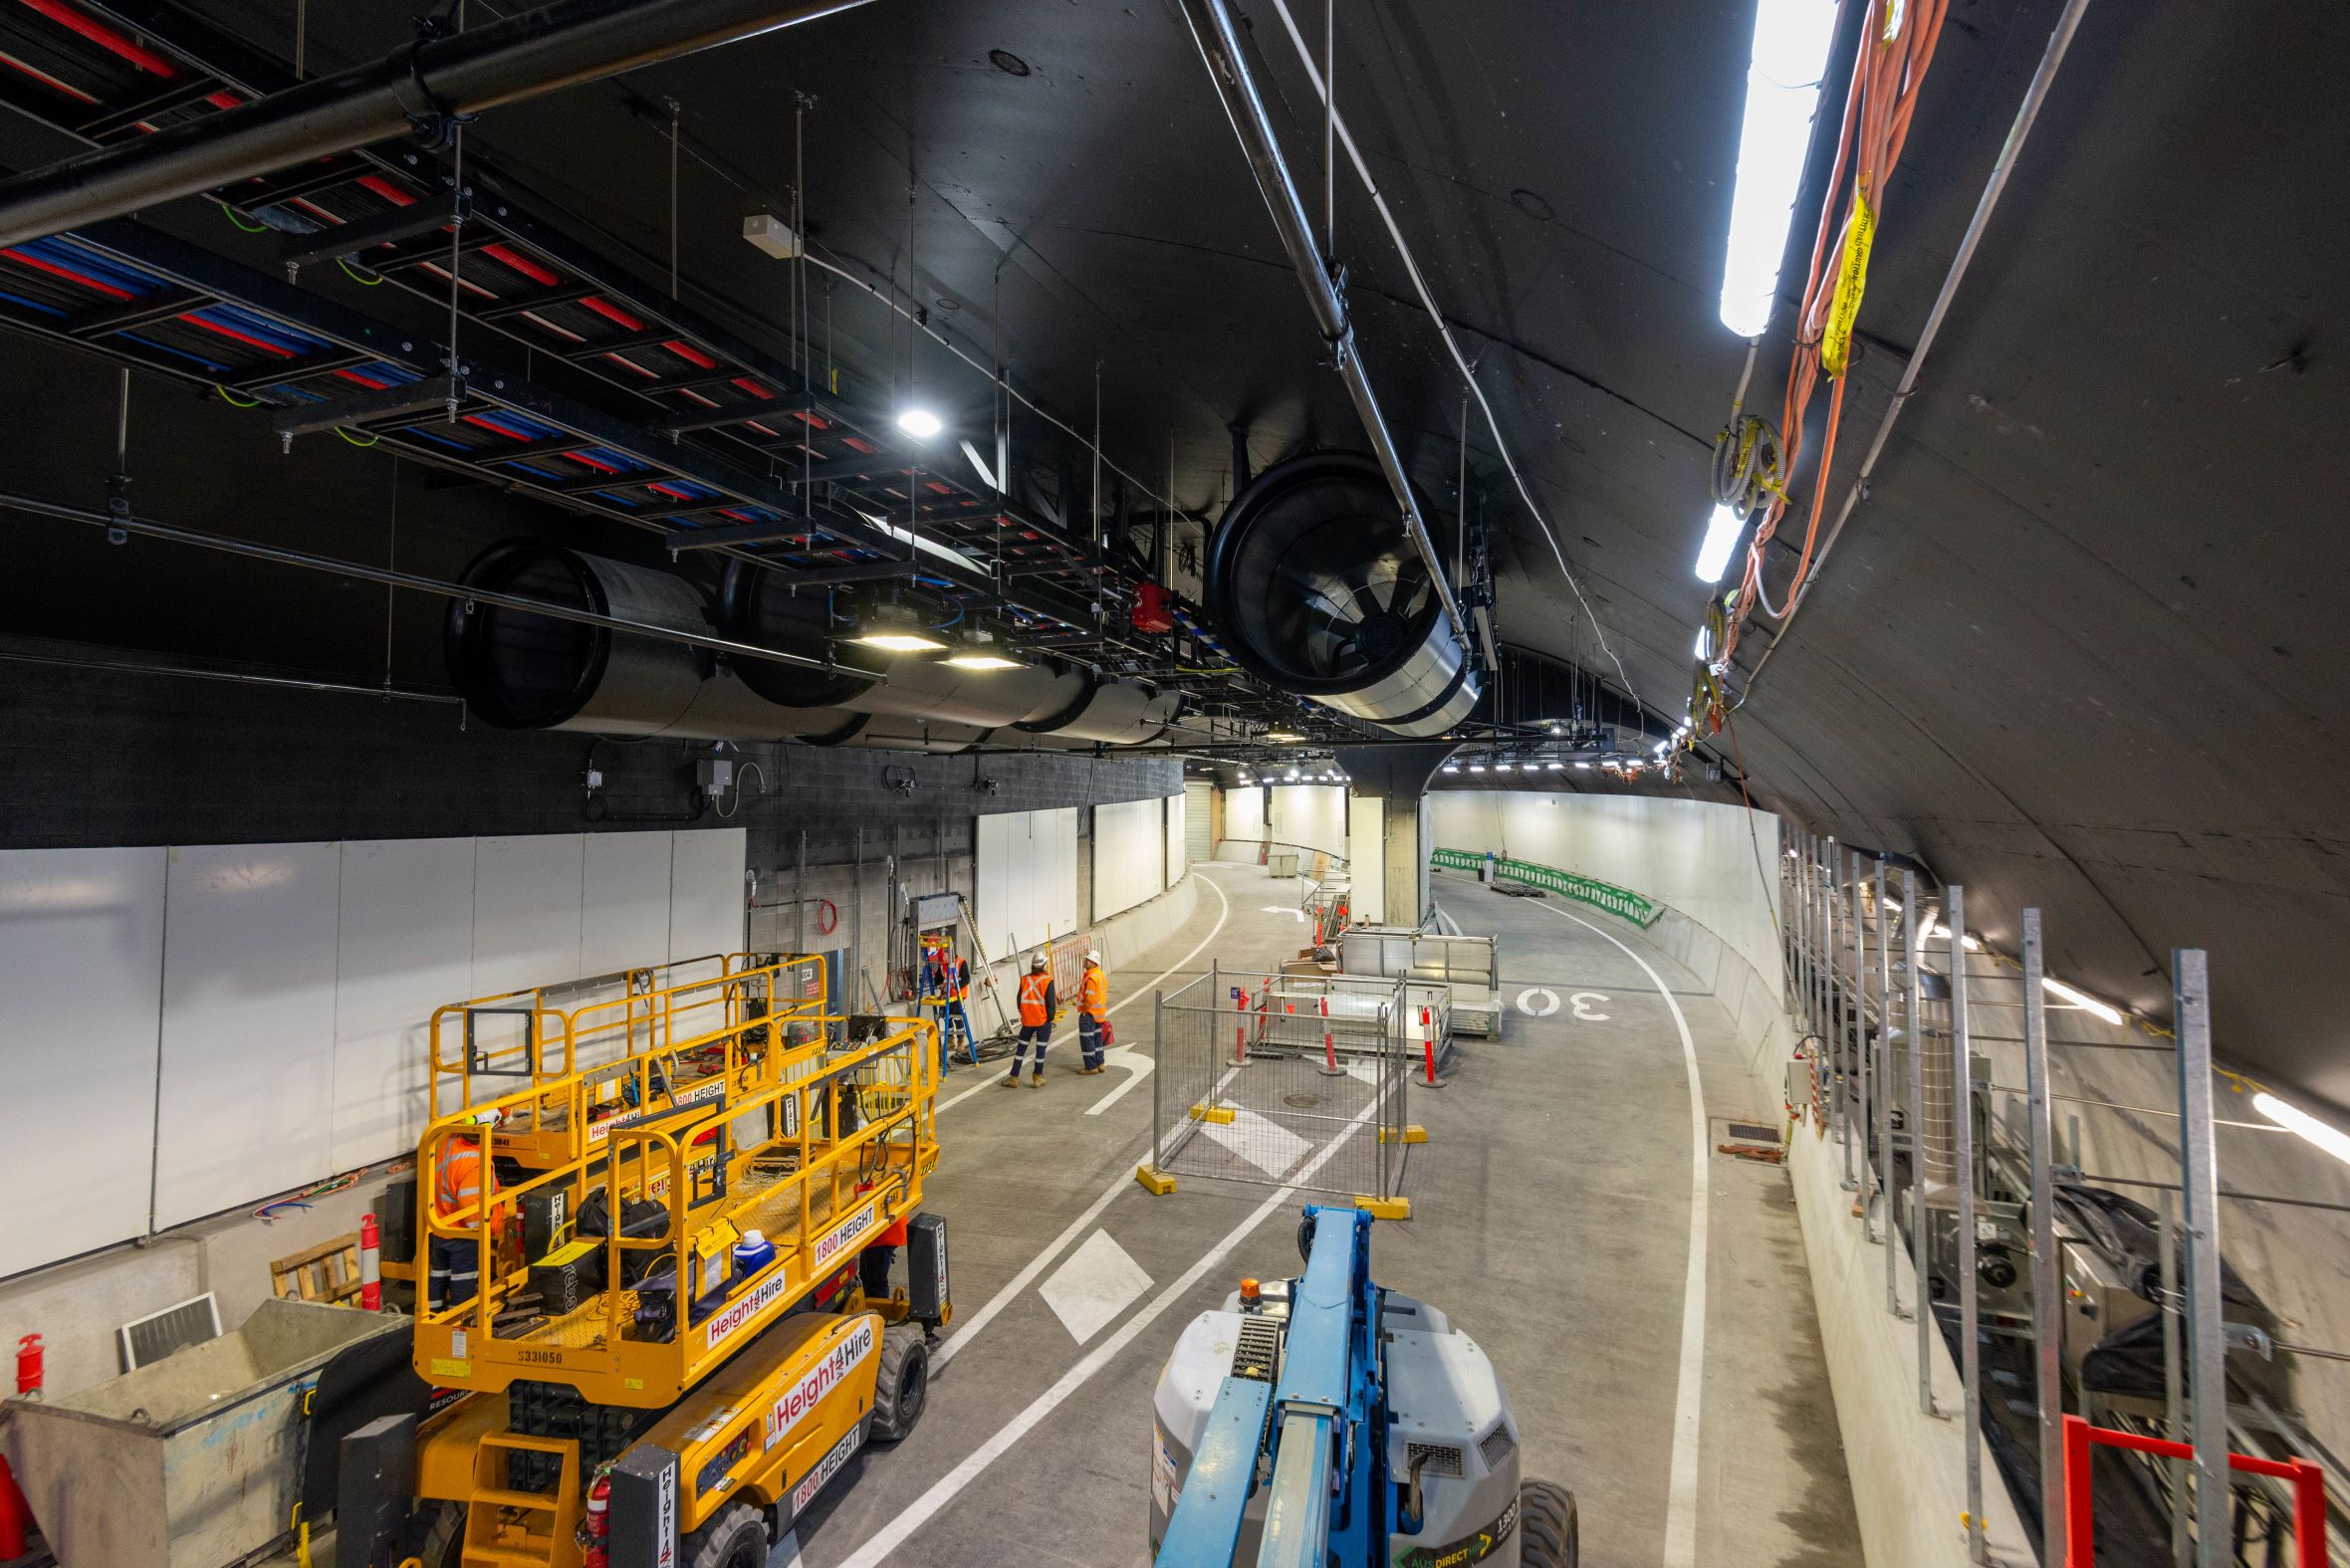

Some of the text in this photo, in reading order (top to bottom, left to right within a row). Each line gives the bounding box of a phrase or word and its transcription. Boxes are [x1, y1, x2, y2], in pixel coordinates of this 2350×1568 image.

[1851, 247, 1864, 282] CAUTION
[1517, 988, 1611, 1021] 30
[677, 1081, 725, 1106] 800 HEIGHT
[816, 1207, 874, 1261] 1800 HEIGHT
[711, 1275, 783, 1341] Height4Hire
[518, 1351, 563, 1365] S331050
[777, 1327, 871, 1431] Height4Hire
[795, 1430, 859, 1509] 1800 HEIGHT
[1498, 1503, 1516, 1533] 1300
